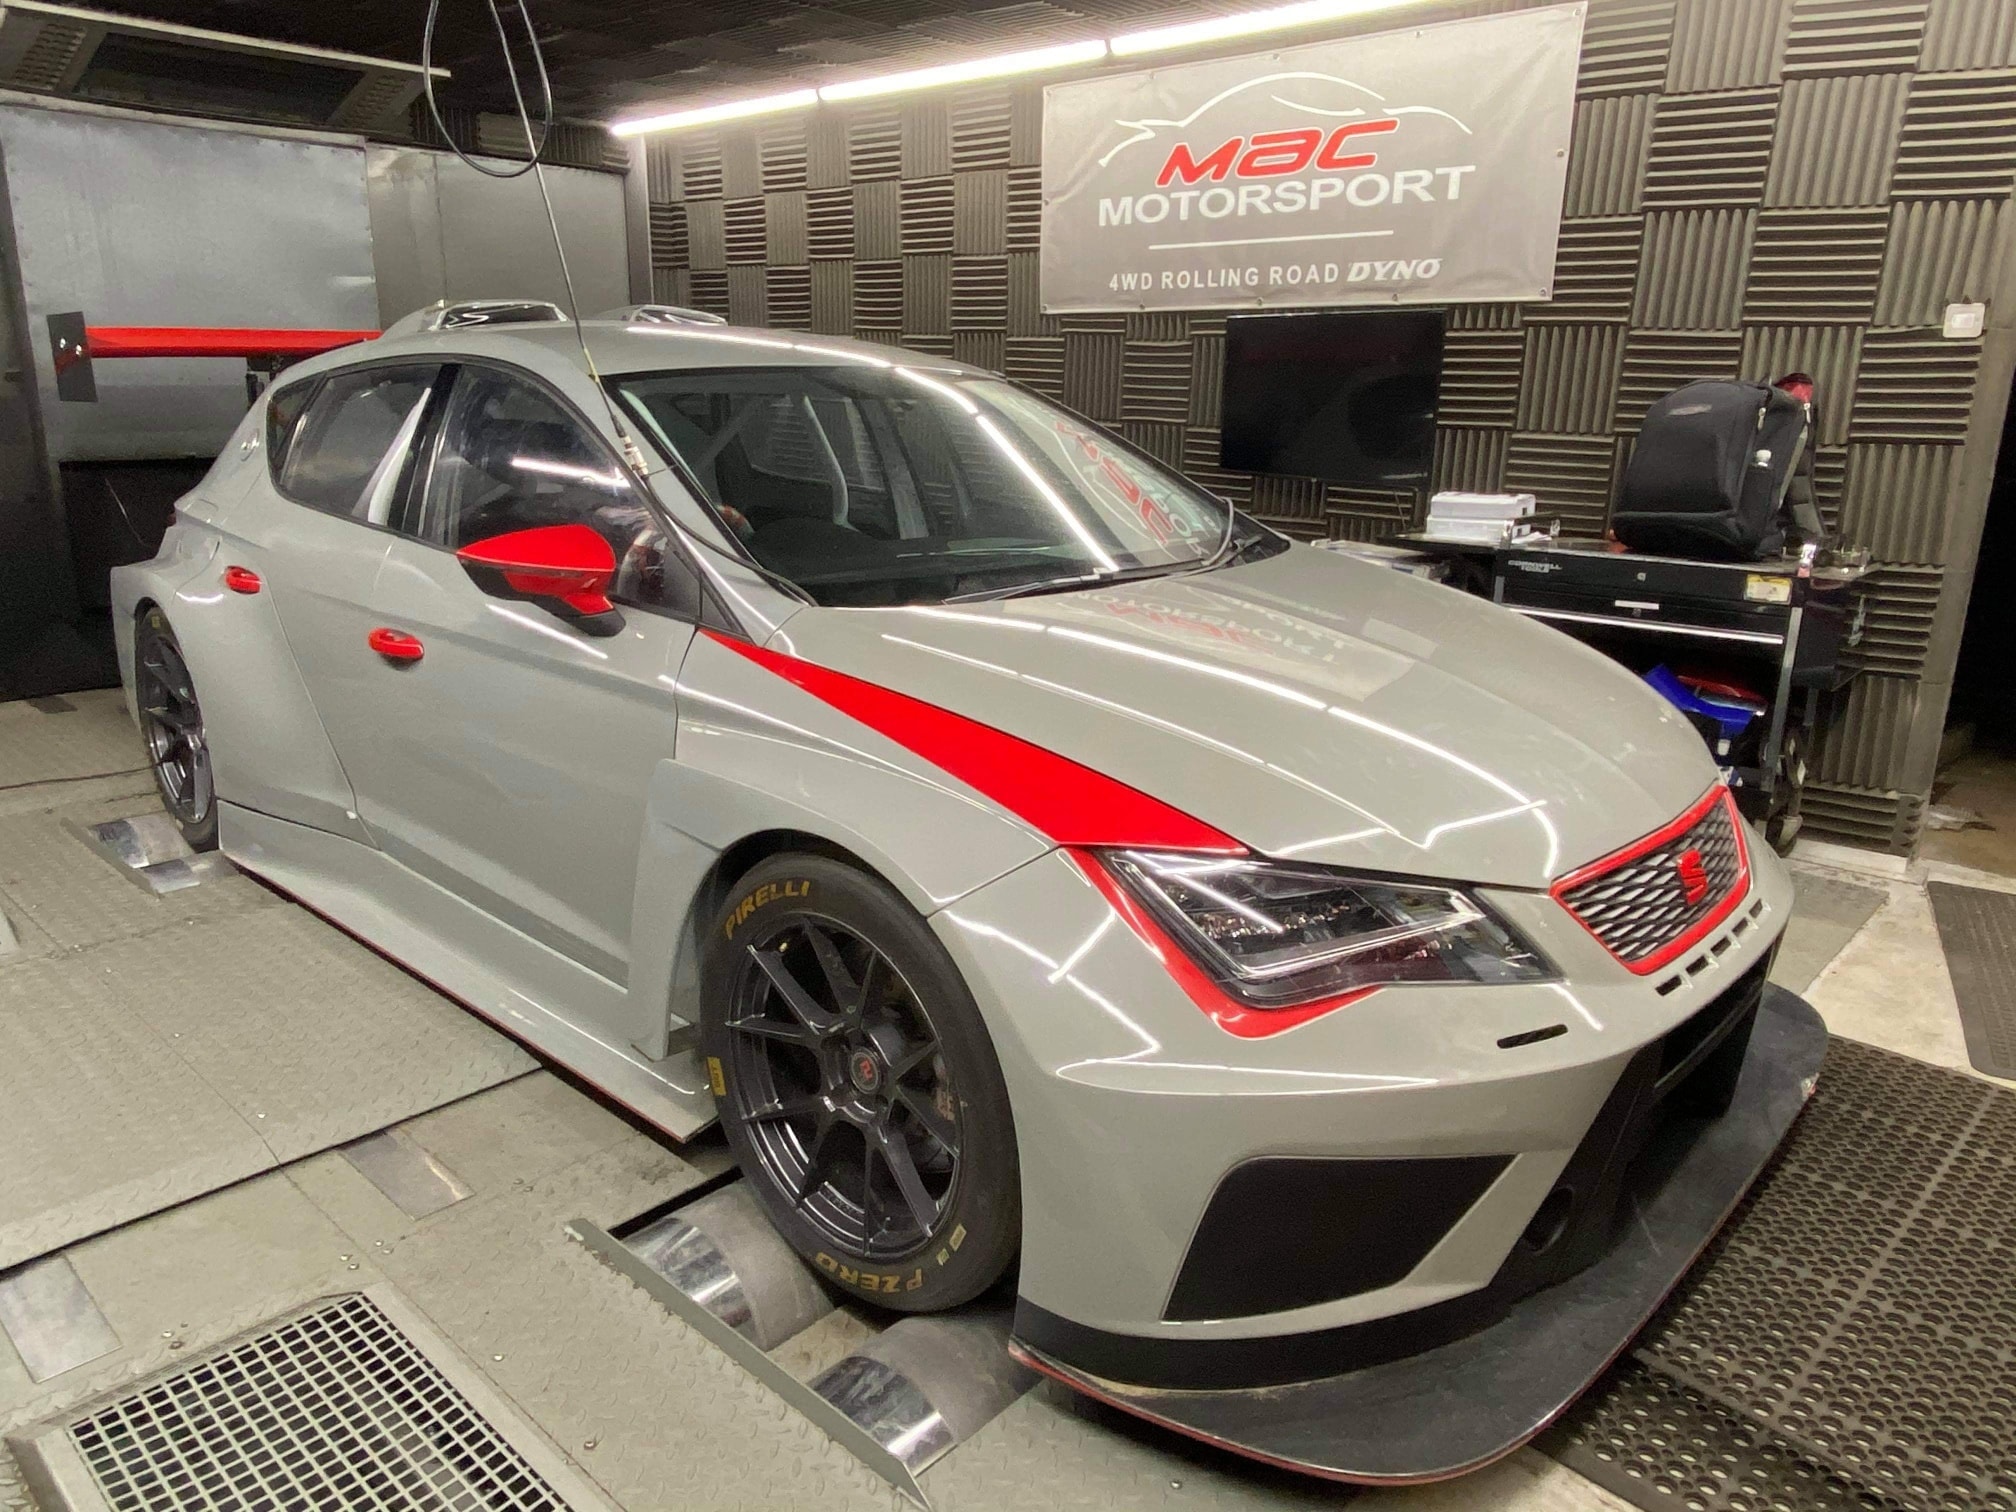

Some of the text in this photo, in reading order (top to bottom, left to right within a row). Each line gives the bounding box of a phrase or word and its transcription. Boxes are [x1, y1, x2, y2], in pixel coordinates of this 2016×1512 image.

[1098, 165, 1477, 227] MOTORSPORT
[1109, 258, 1443, 291] 4WD ROLLING ROAD DYNO
[725, 880, 811, 941] PIRELLI
